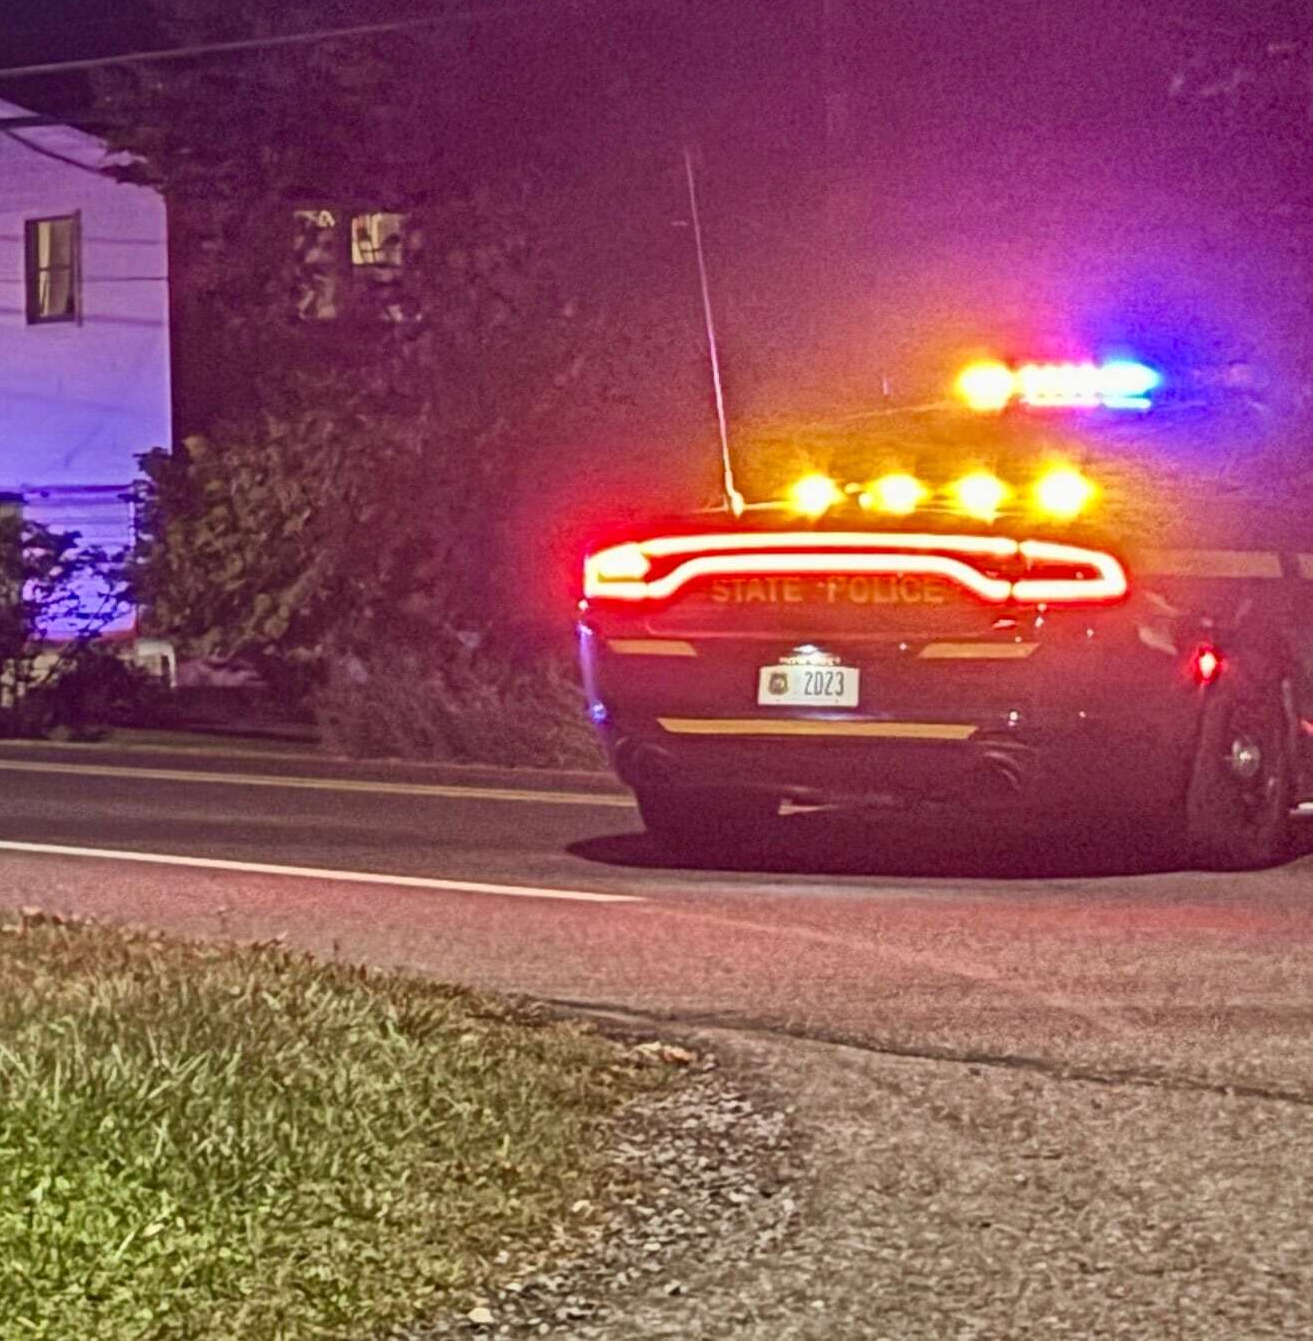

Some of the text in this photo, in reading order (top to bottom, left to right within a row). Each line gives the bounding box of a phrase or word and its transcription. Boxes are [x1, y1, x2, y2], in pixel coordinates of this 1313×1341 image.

[711, 574, 944, 604] STATE POLICE
[803, 670, 845, 697] 2023
